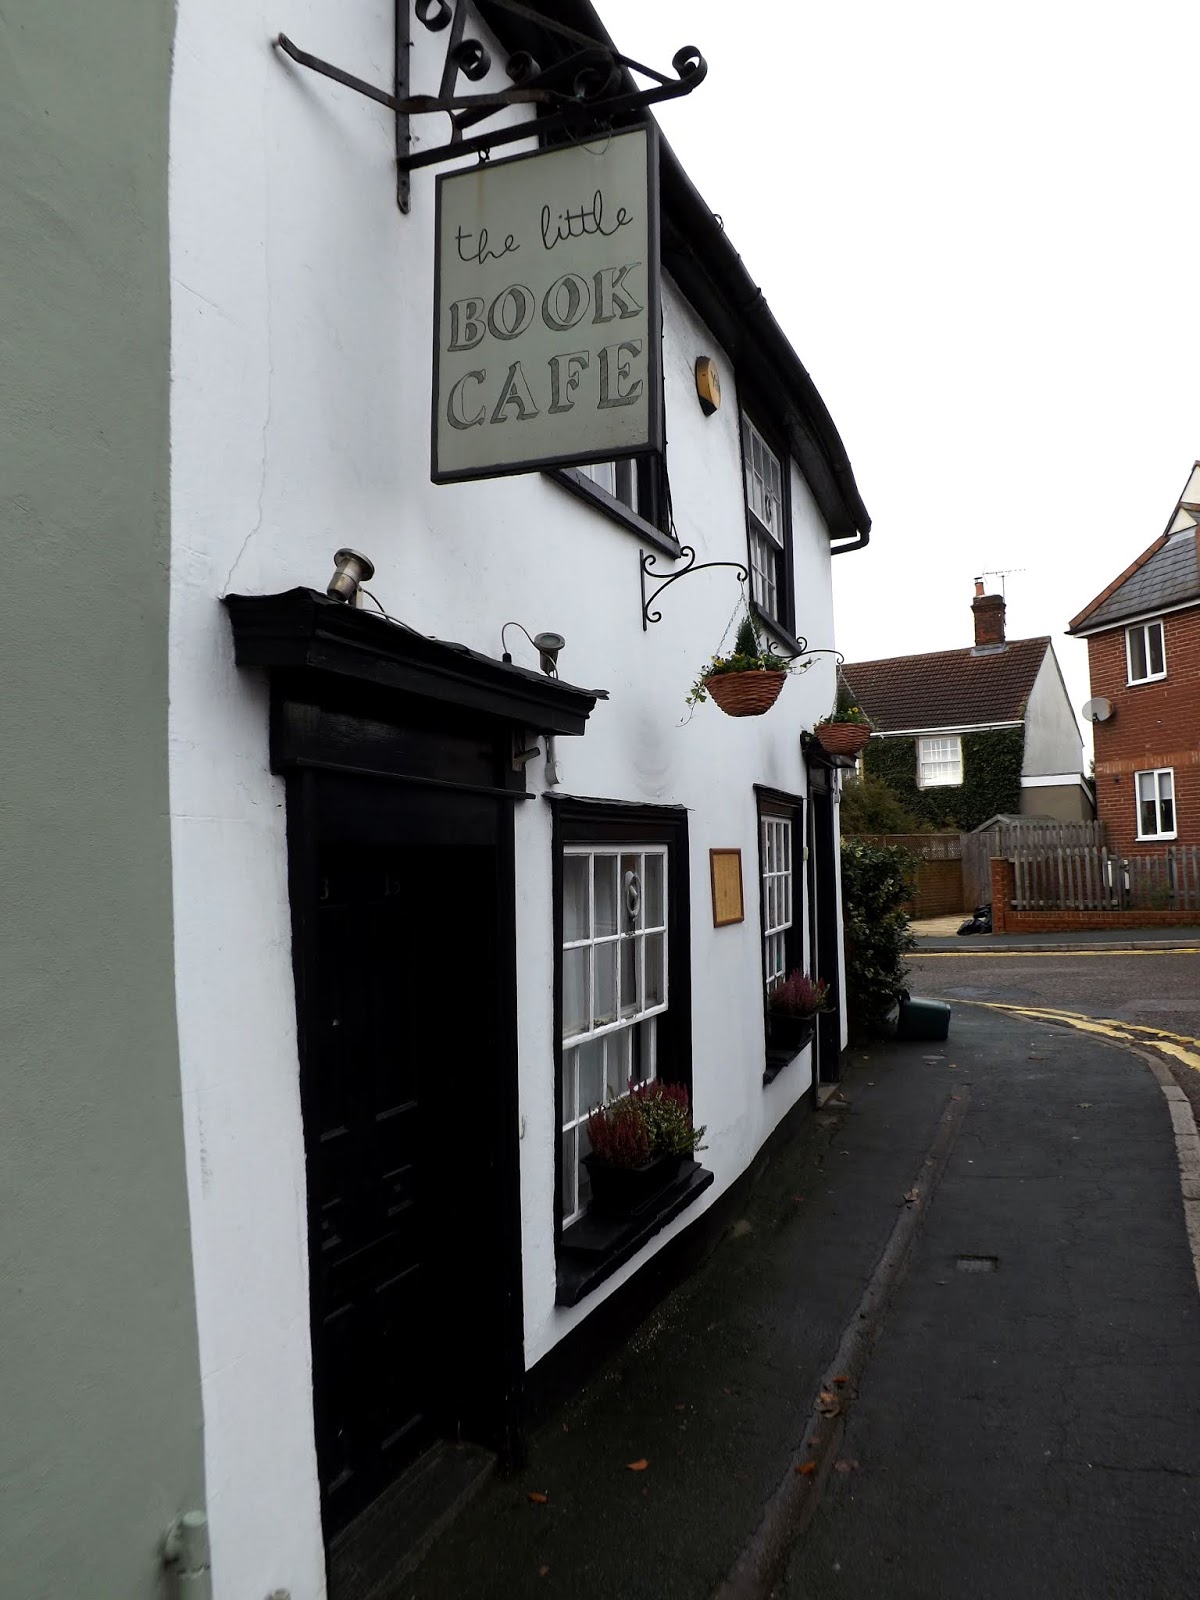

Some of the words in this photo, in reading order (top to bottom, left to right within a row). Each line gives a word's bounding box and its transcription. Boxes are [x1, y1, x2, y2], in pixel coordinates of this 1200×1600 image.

[455, 225, 520, 264] the
[541, 189, 634, 250] little
[447, 262, 643, 352] BOOK
[446, 339, 643, 430] CAFE
